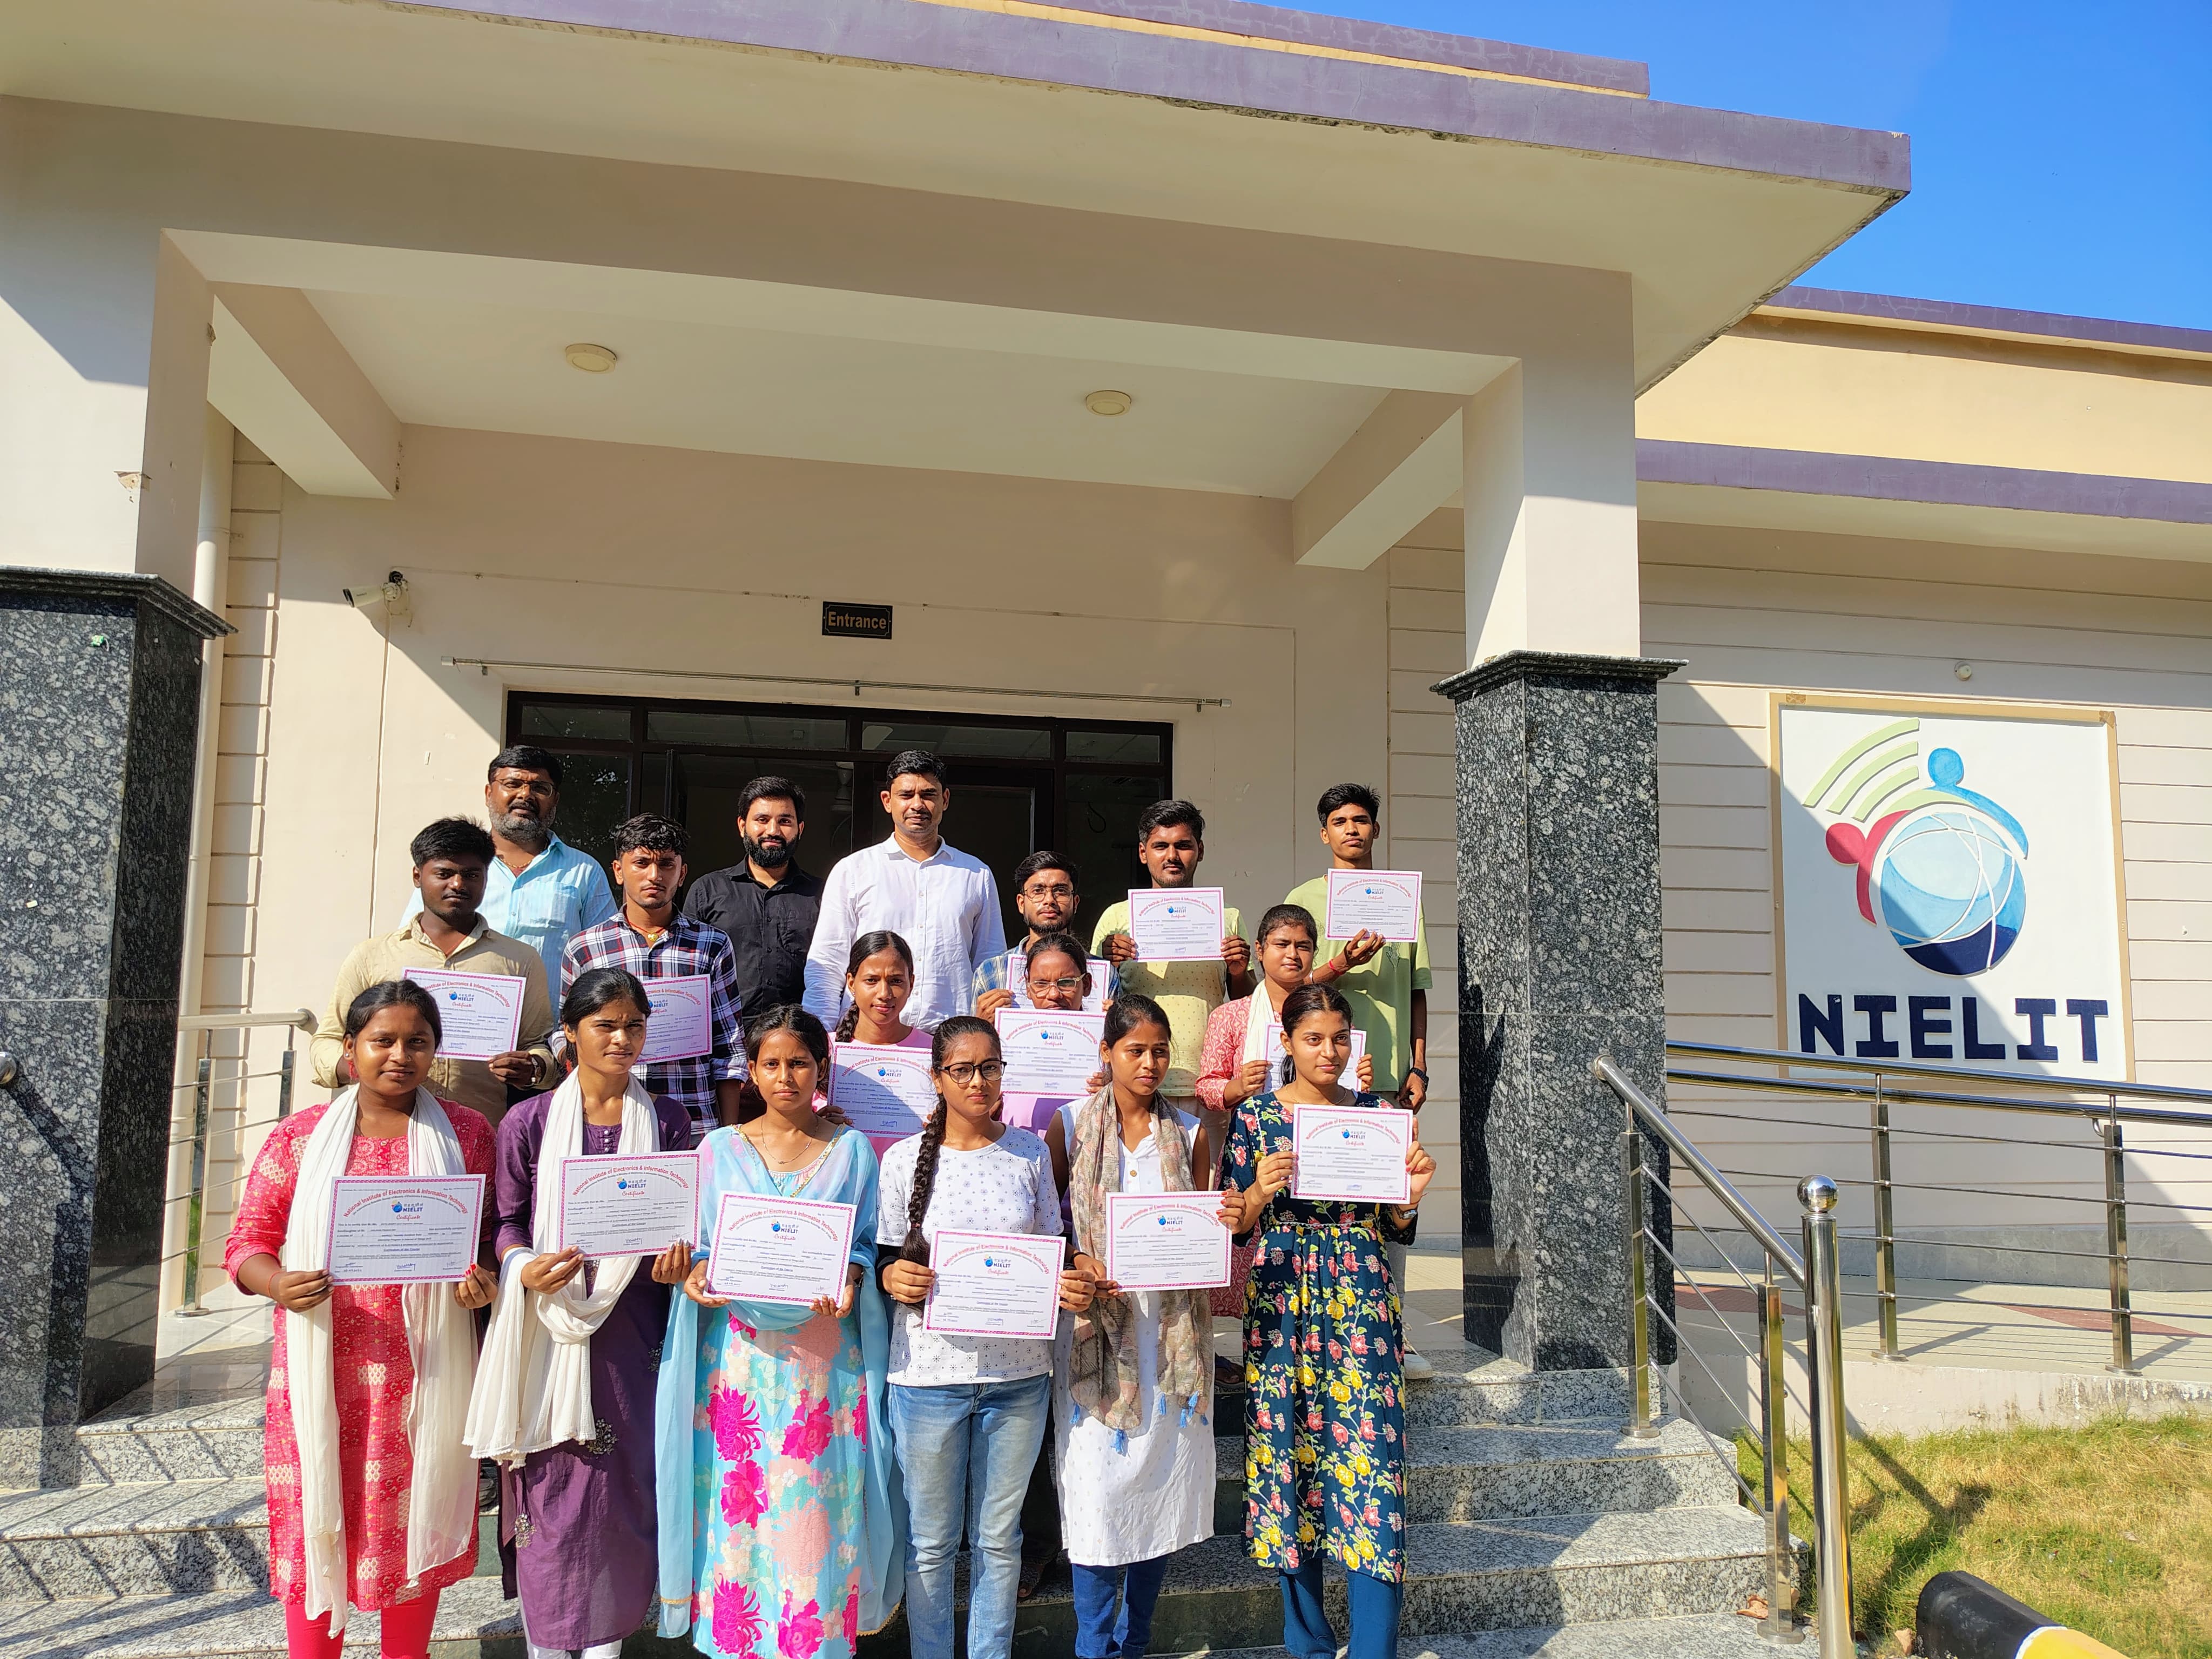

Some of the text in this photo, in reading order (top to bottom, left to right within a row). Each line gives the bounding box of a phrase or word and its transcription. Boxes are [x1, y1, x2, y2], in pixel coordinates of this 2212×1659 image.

[828, 611, 887, 629] Entrance
[1799, 993, 2108, 1062] NIELIT
[572, 1179, 589, 1196] National
[589, 1171, 606, 1181] Institute
[644, 1165, 669, 1174] Information
[669, 1170, 689, 1188] Technology
[343, 1201, 361, 1217] National
[361, 1193, 381, 1203] Institute
[421, 1189, 447, 1198] Information
[449, 1194, 468, 1214] Technology
[729, 1216, 745, 1231] National
[745, 1211, 763, 1219] Institute
[798, 1211, 820, 1223] Information
[821, 1221, 838, 1242] Technology
